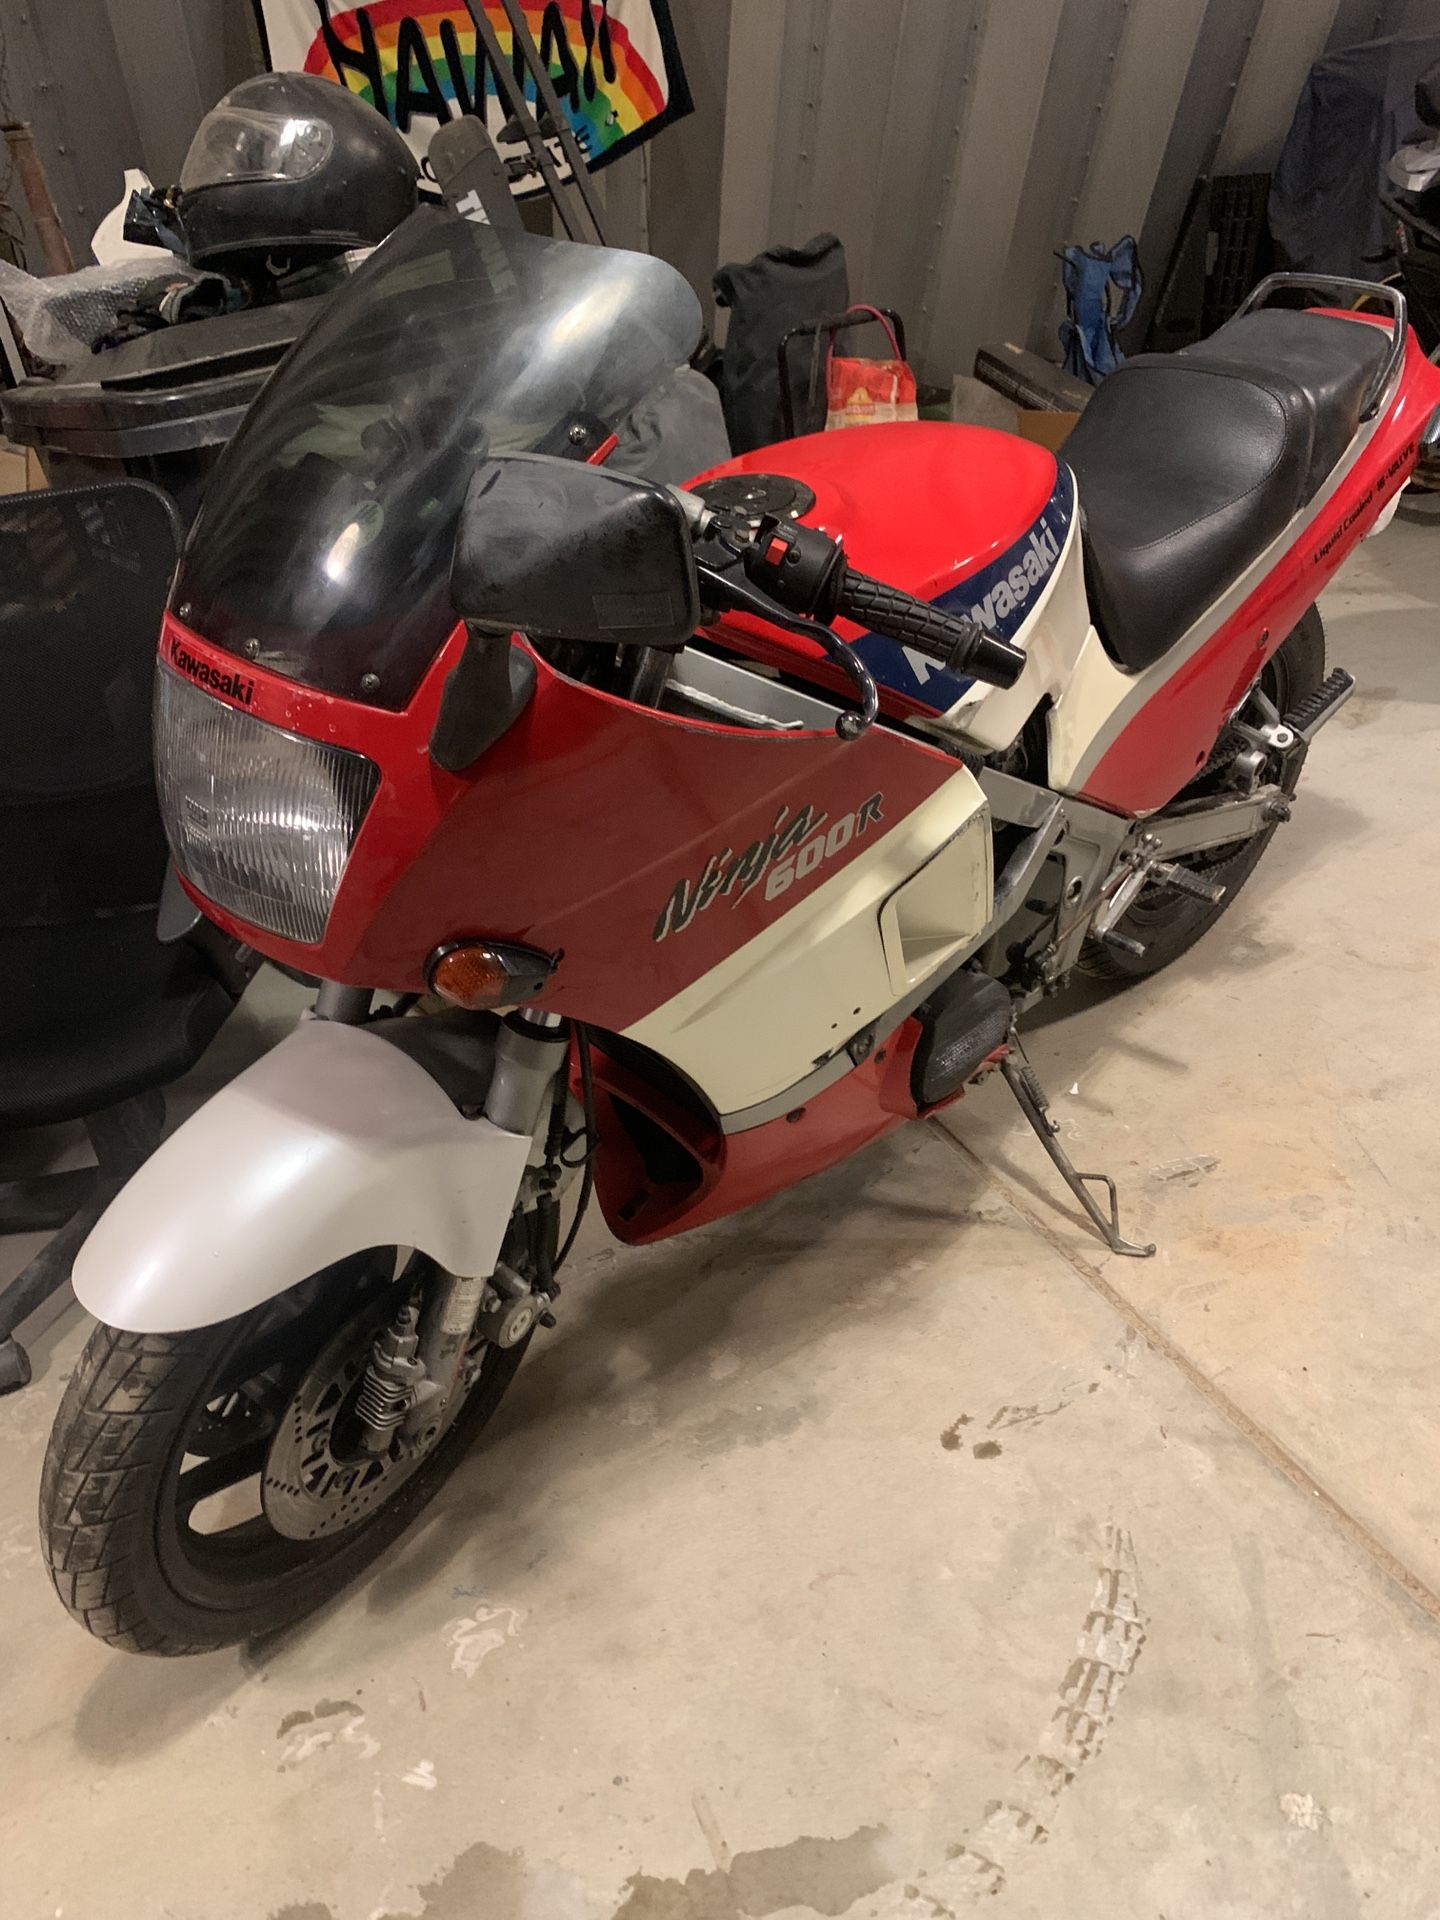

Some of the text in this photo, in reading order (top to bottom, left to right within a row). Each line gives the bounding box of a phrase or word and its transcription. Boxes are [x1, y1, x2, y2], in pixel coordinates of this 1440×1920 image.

[1313, 526, 1343, 564] Liquid
[1342, 490, 1374, 532] Cooled
[901, 516, 1060, 686] Kwasaki
[170, 636, 255, 705] Kawasaki
[652, 790, 884, 943] Ninja 600R
